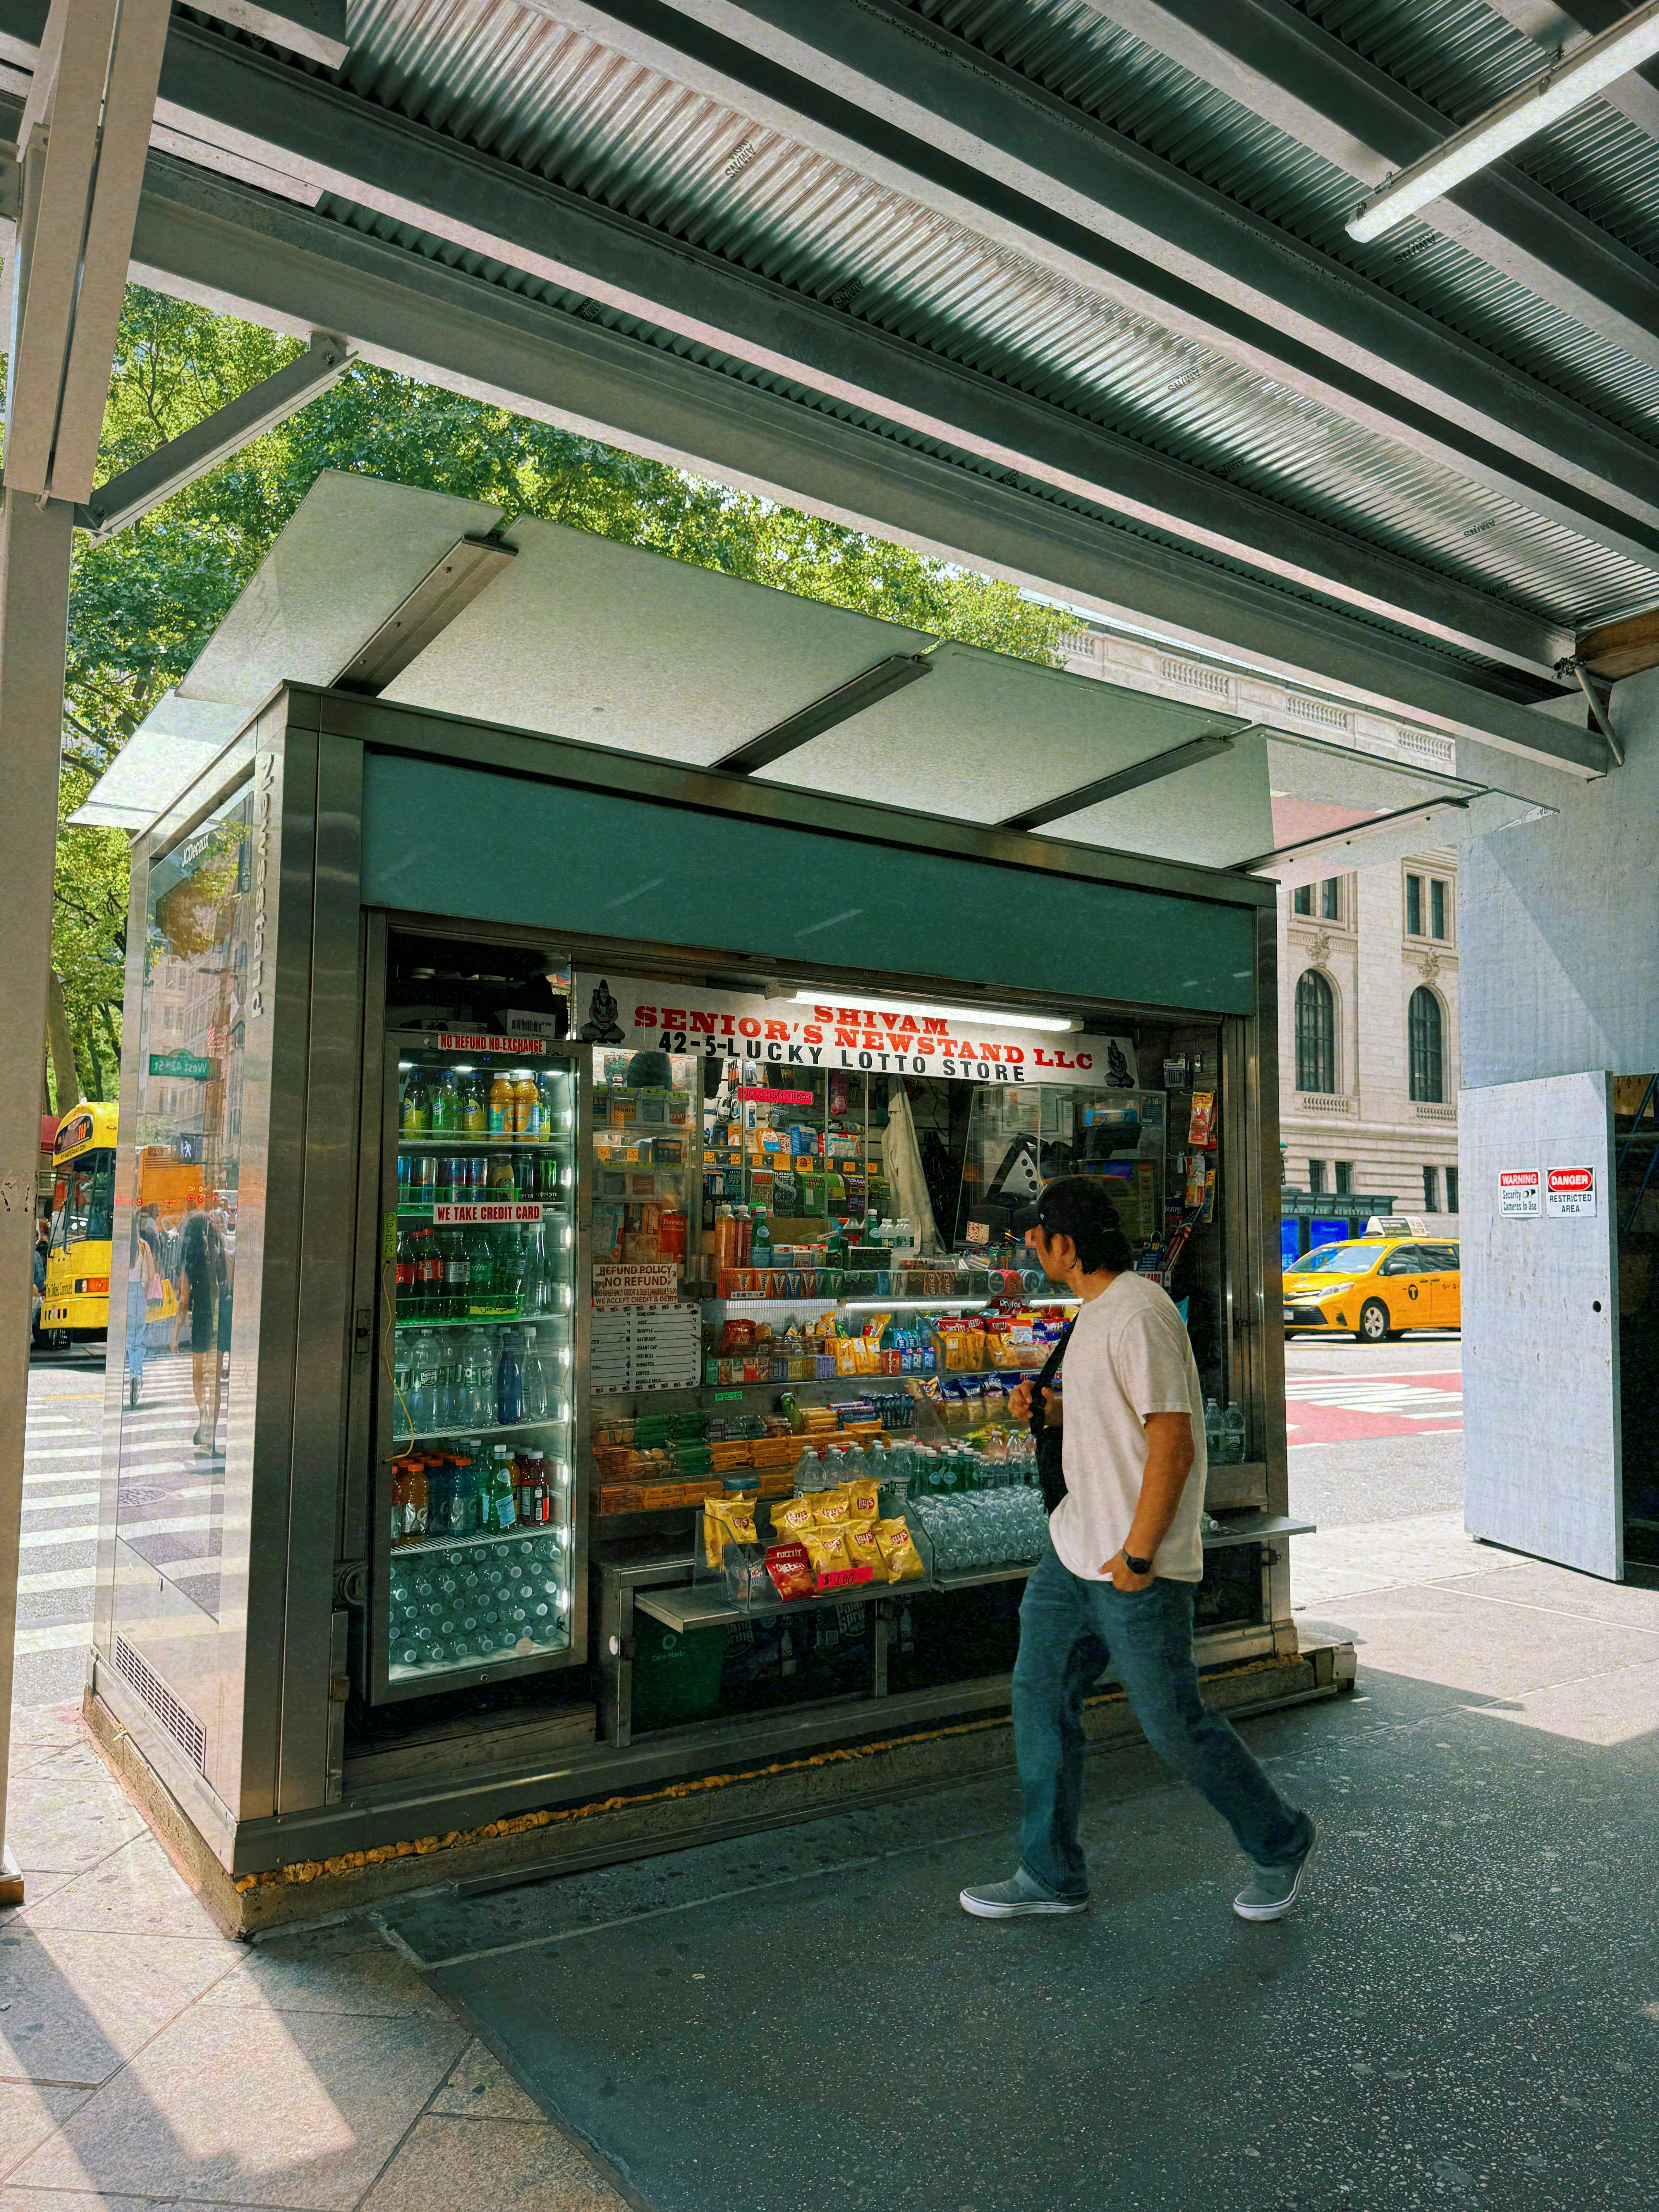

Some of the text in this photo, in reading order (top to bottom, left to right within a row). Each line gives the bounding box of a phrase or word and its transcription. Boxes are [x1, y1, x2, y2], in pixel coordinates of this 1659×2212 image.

[182, 833, 209, 867] JCDecaux
[814, 1005, 948, 1036] SHIVAM
[441, 1034, 543, 1052] NO REFUND NO EXCHANGE
[634, 1006, 1093, 1069] SENIOR'S NEWSTAND LLC
[841, 1049, 926, 1073] LOTTO
[943, 1059, 1025, 1081] STORE
[778, 1158, 783, 1166] 5
[1502, 1174, 1537, 1185] WARNING
[1551, 1174, 1588, 1186] DANGER
[1503, 1190, 1521, 1200] Security
[1549, 1194, 1592, 1203] RESTRICTED
[1503, 1202, 1537, 1211] Cameras In Use
[438, 1206, 540, 1221] WE TAKE CREDIT CARD
[384, 1213, 394, 1253] OPEN
[601, 1266, 672, 1274] REFUND POLICY
[605, 1276, 667, 1286] NO REFUND
